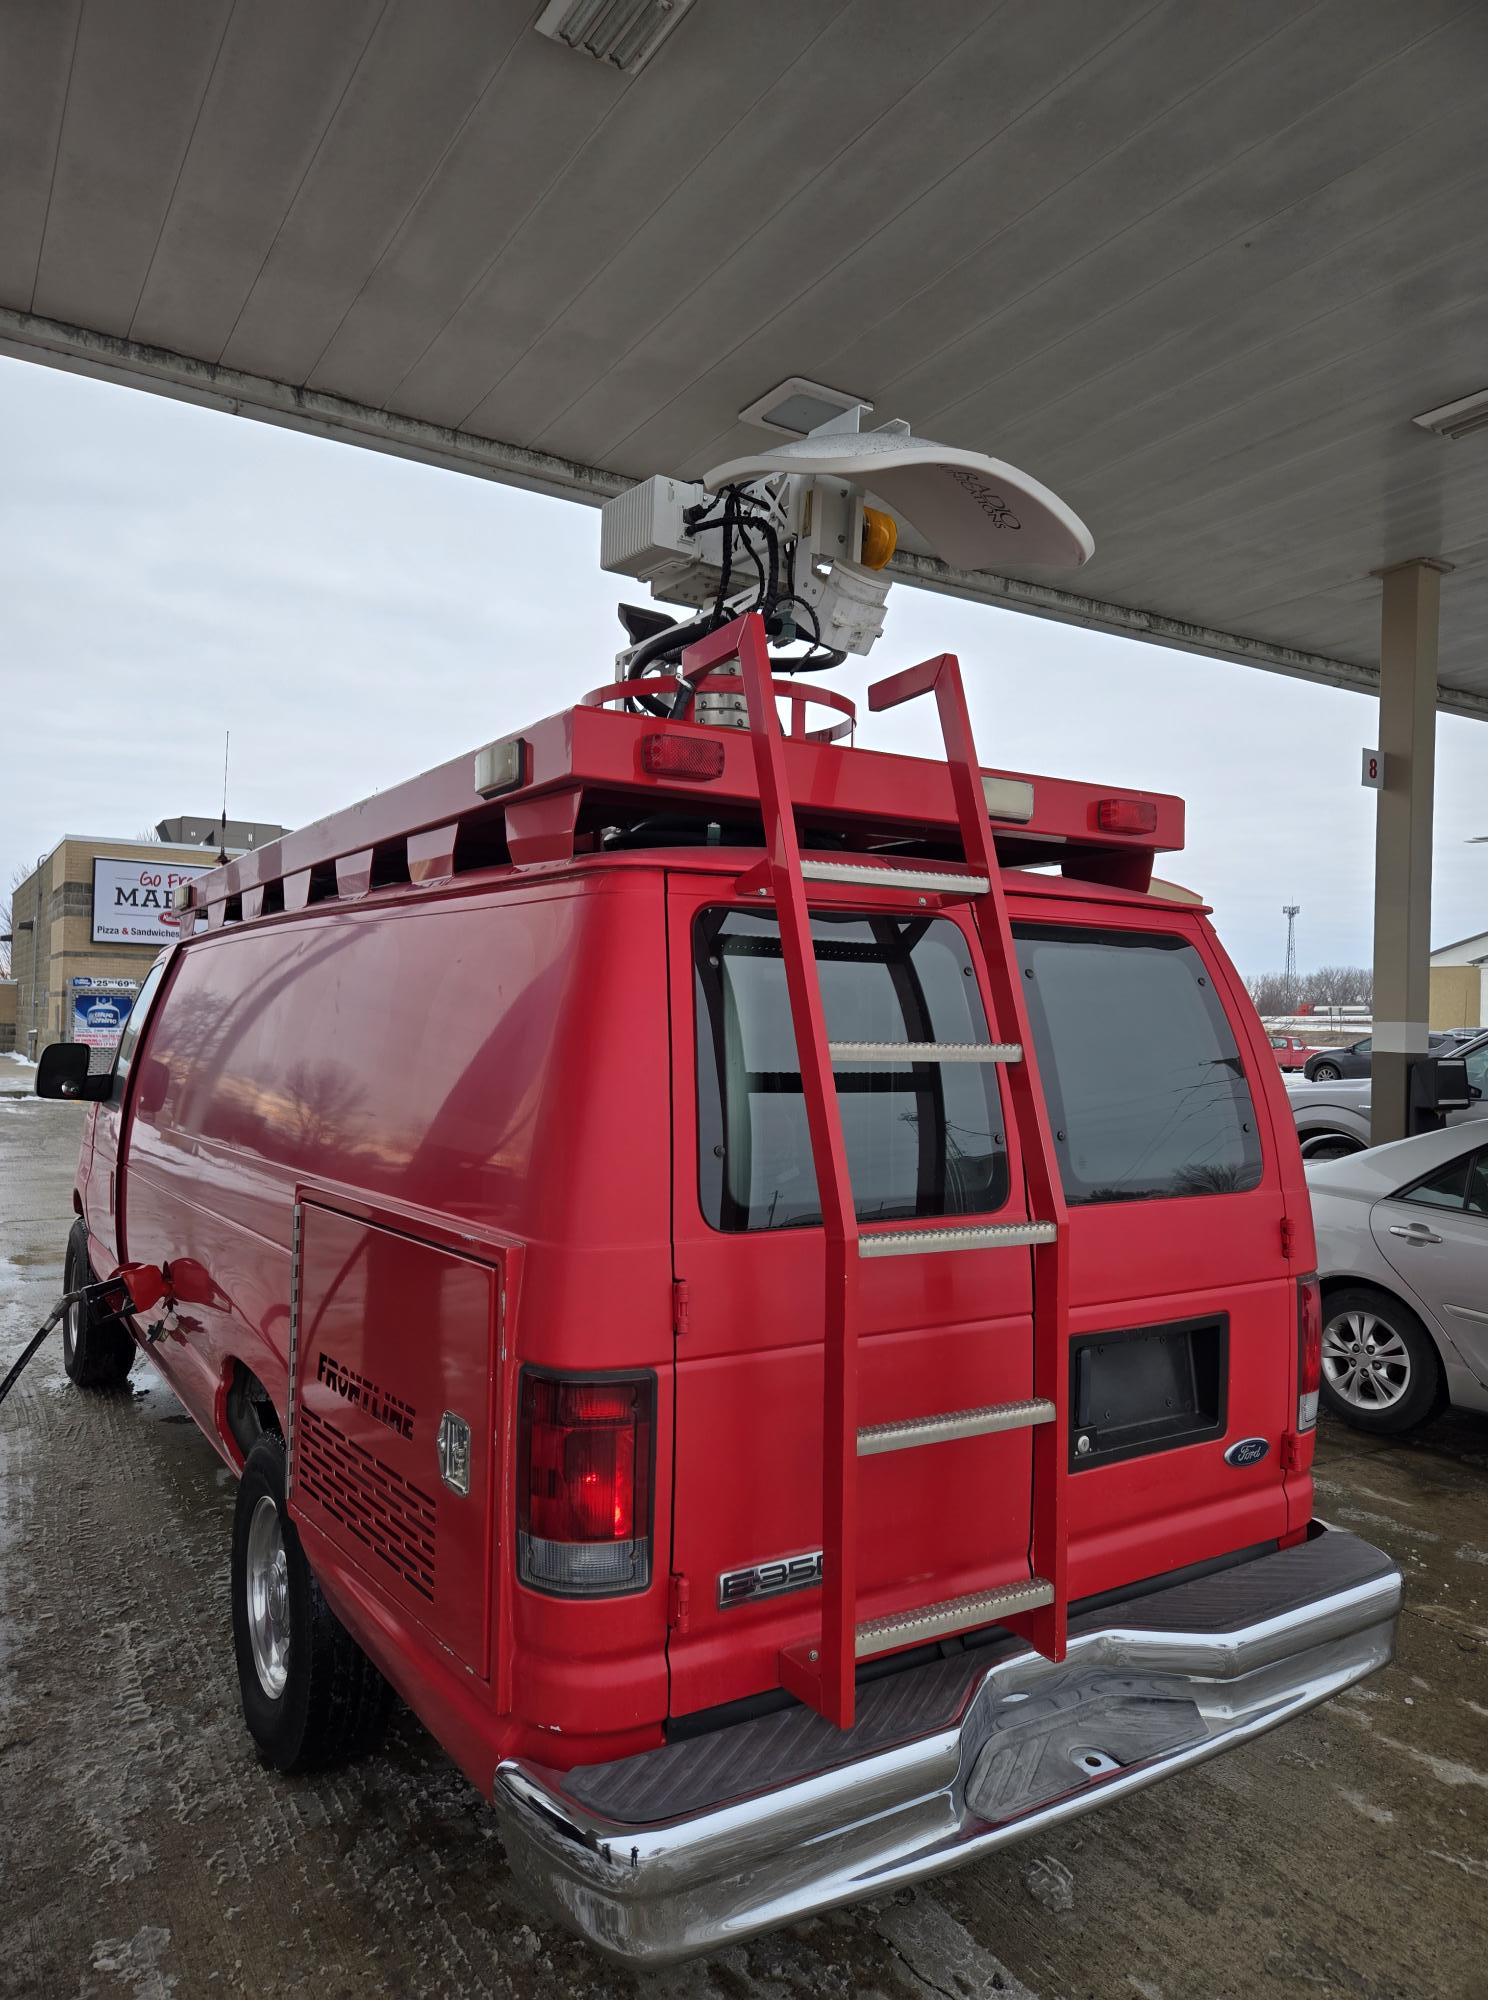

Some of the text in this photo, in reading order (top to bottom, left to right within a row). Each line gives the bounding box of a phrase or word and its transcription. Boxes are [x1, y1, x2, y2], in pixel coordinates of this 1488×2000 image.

[935, 463, 1007, 529] UNICATIONS
[952, 471, 1021, 530] RADIO
[1369, 758, 1378, 779] 8
[140, 871, 161, 888] Go
[97, 925, 180, 938] Pizza & Sandwiches
[317, 1352, 417, 1441] FRONTLINE
[1237, 1443, 1263, 1462] Ford
[722, 1554, 822, 1600] E-35
